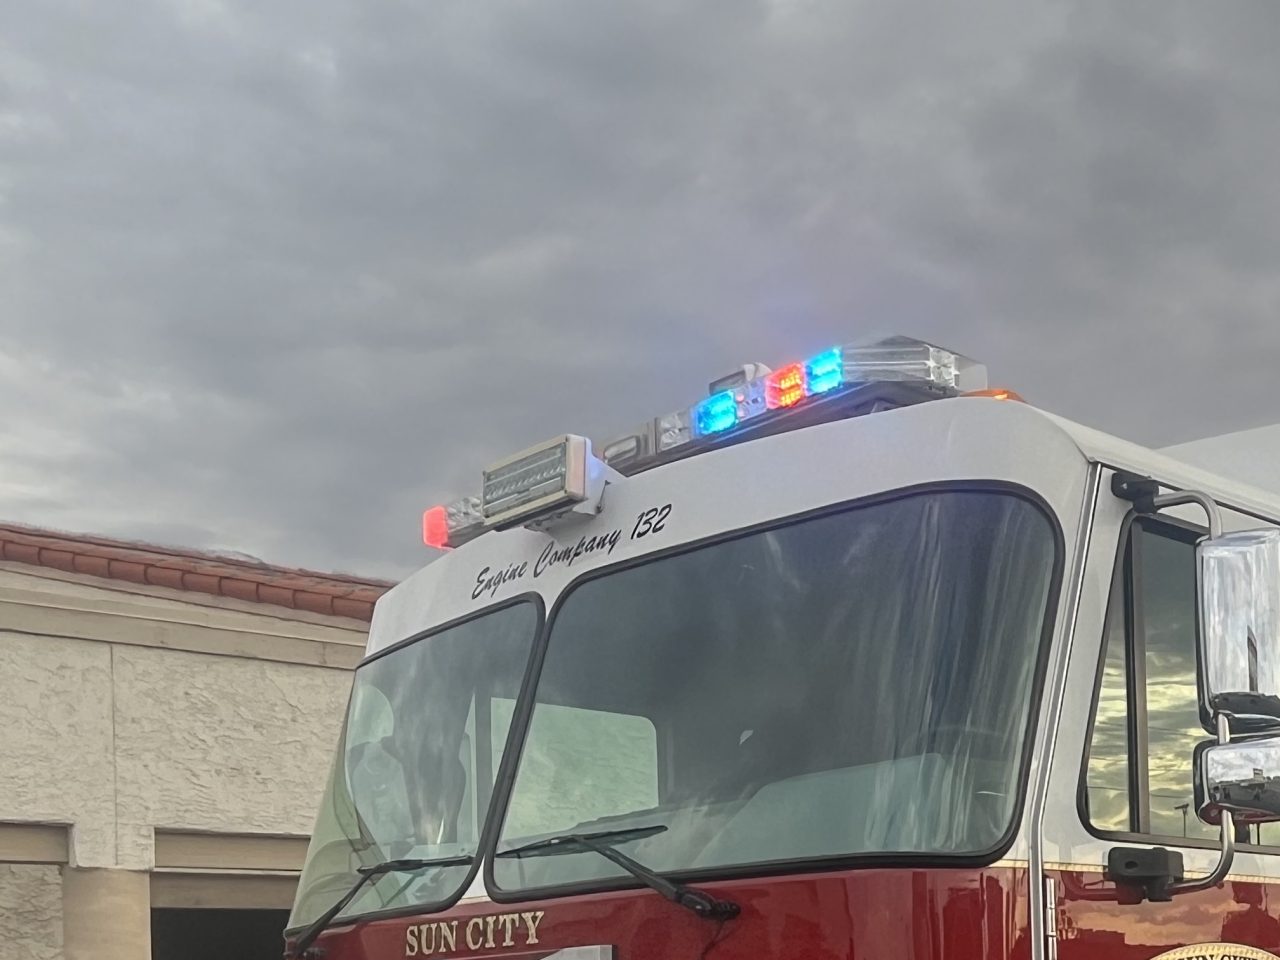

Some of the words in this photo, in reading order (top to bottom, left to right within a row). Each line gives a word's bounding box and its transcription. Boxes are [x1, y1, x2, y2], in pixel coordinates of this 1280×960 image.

[471, 562, 527, 600] Engine
[534, 528, 622, 578] Company
[631, 504, 672, 540] 132
[405, 921, 459, 957] SUN
[466, 911, 545, 950] CITY
